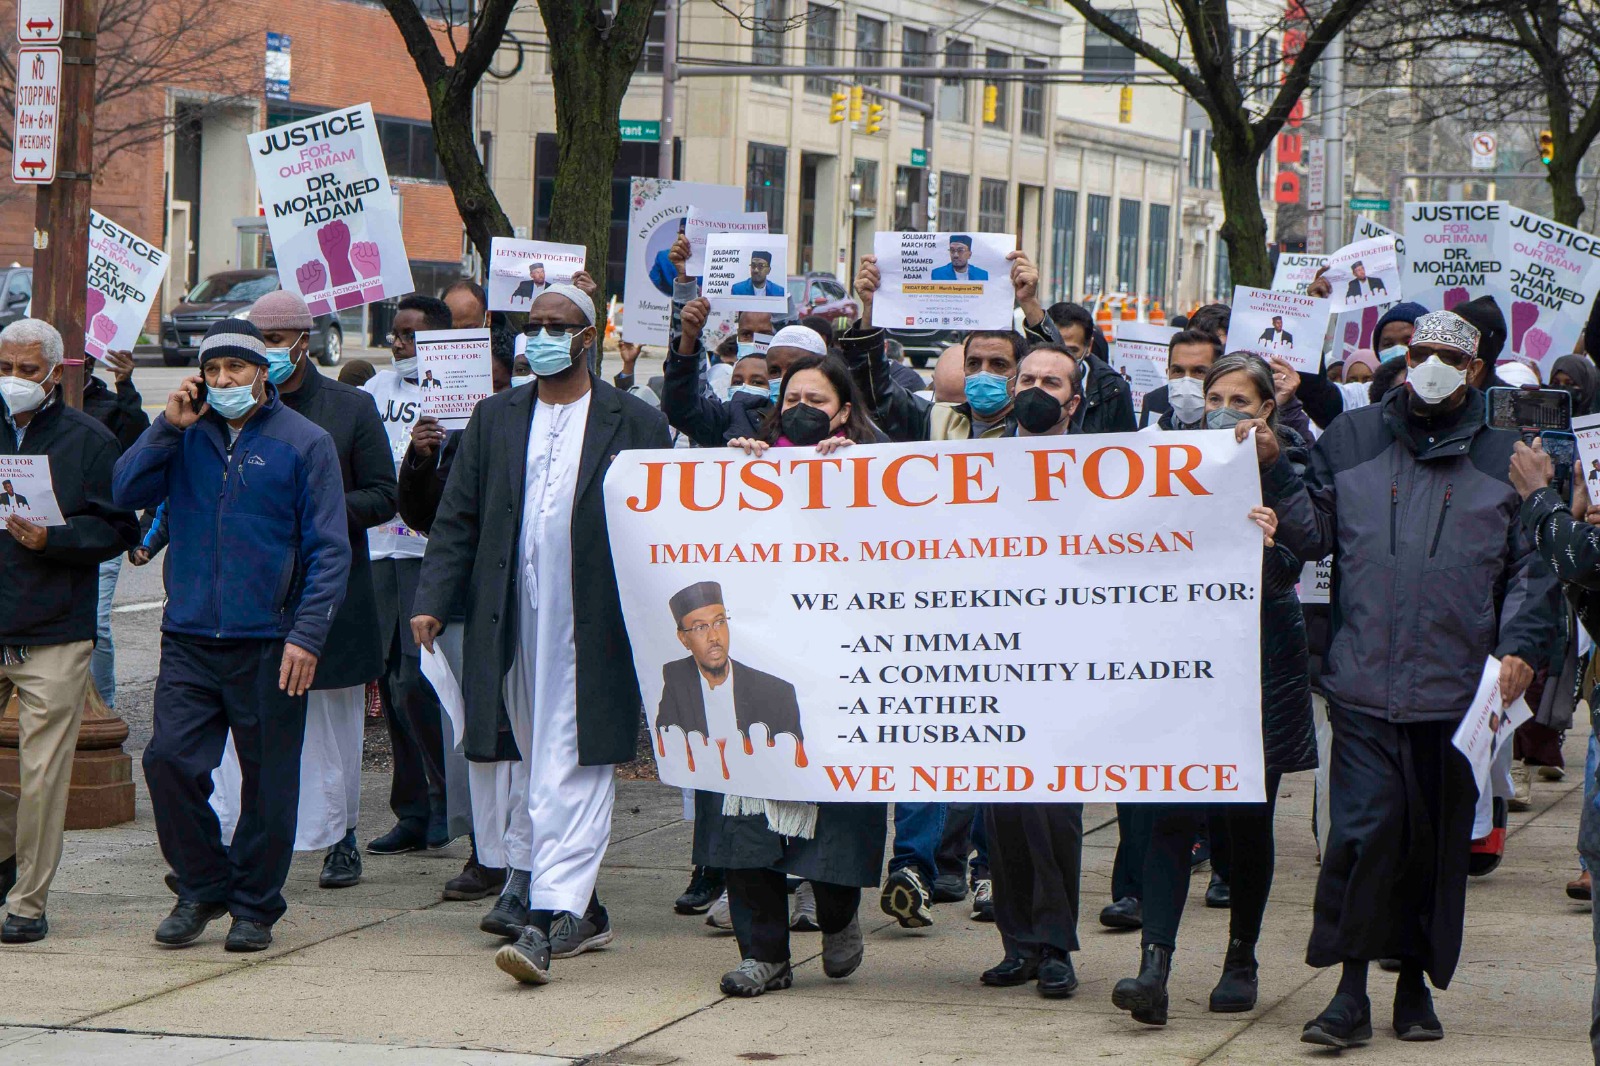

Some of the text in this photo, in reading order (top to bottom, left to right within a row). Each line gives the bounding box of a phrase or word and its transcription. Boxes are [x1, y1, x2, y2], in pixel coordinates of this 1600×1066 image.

[32, 60, 45, 80] NO
[19, 86, 56, 106] STOPPING
[19, 110, 53, 129] 4PM-6PM
[260, 110, 364, 156] JUSTICE
[620, 126, 642, 136] rant
[19, 136, 51, 149] WEEKDAYS
[300, 142, 332, 160] FOR
[279, 148, 356, 178] OUR IMAM
[306, 172, 341, 192] DR.
[273, 178, 380, 218] MOHAMED
[304, 198, 364, 226] ADAM
[1412, 206, 1500, 222] JUSTICE
[638, 205, 682, 240] IN LOVING
[688, 218, 704, 226] LET'S
[705, 221, 726, 230] STAND
[1443, 224, 1469, 234] FOR
[90, 214, 162, 266] USTICE
[1424, 234, 1488, 244] OUR IMAM
[1510, 214, 1600, 258] JUSTICE
[89, 238, 142, 274] UR IMAM
[102, 238, 128, 256] FOR
[496, 249, 584, 264] LET'S STAND TOGETHER
[1360, 244, 1395, 258] TOGETHER
[1444, 248, 1472, 260] DR.
[1538, 240, 1566, 258] FOR
[94, 254, 120, 278] DR.
[1283, 256, 1328, 266] JUSTIC
[1413, 261, 1502, 273] MOHAMED
[1513, 242, 1582, 274] OUR IMAM
[88, 262, 146, 303] HAMED
[1434, 274, 1485, 286] ADAM
[1527, 263, 1556, 282] DR.
[88, 276, 126, 304] DAM
[312, 278, 380, 301] TAKE ACTION NOW!
[1510, 270, 1585, 306] OHAMED
[1510, 284, 1563, 312] ADAM
[638, 300, 670, 312] Mohamed
[1249, 291, 1291, 303] JUSTICE
[1294, 297, 1314, 306] FOR
[1262, 302, 1288, 310] IMMAM
[1250, 305, 1310, 318] MOHAMED HASSAN
[450, 342, 488, 350] SEEKING
[424, 354, 460, 362] JUSTICE
[424, 394, 464, 402] JUSTICE
[14, 458, 34, 466] FOR
[626, 444, 1214, 512] JUSTICE FOR
[649, 530, 1196, 564] IMMAM DR. MOHAMED HASSAN
[790, 582, 1255, 611] WE ARE SEEKING JUSTICE FOR:
[840, 632, 1022, 654] -AN IMMAM
[840, 660, 1215, 684] -A COMMUNITY LEADER
[838, 695, 1000, 716] -A FATHER
[838, 724, 1026, 744] -A HUSBAND
[823, 764, 1240, 793] WE NEED JUSTICE
